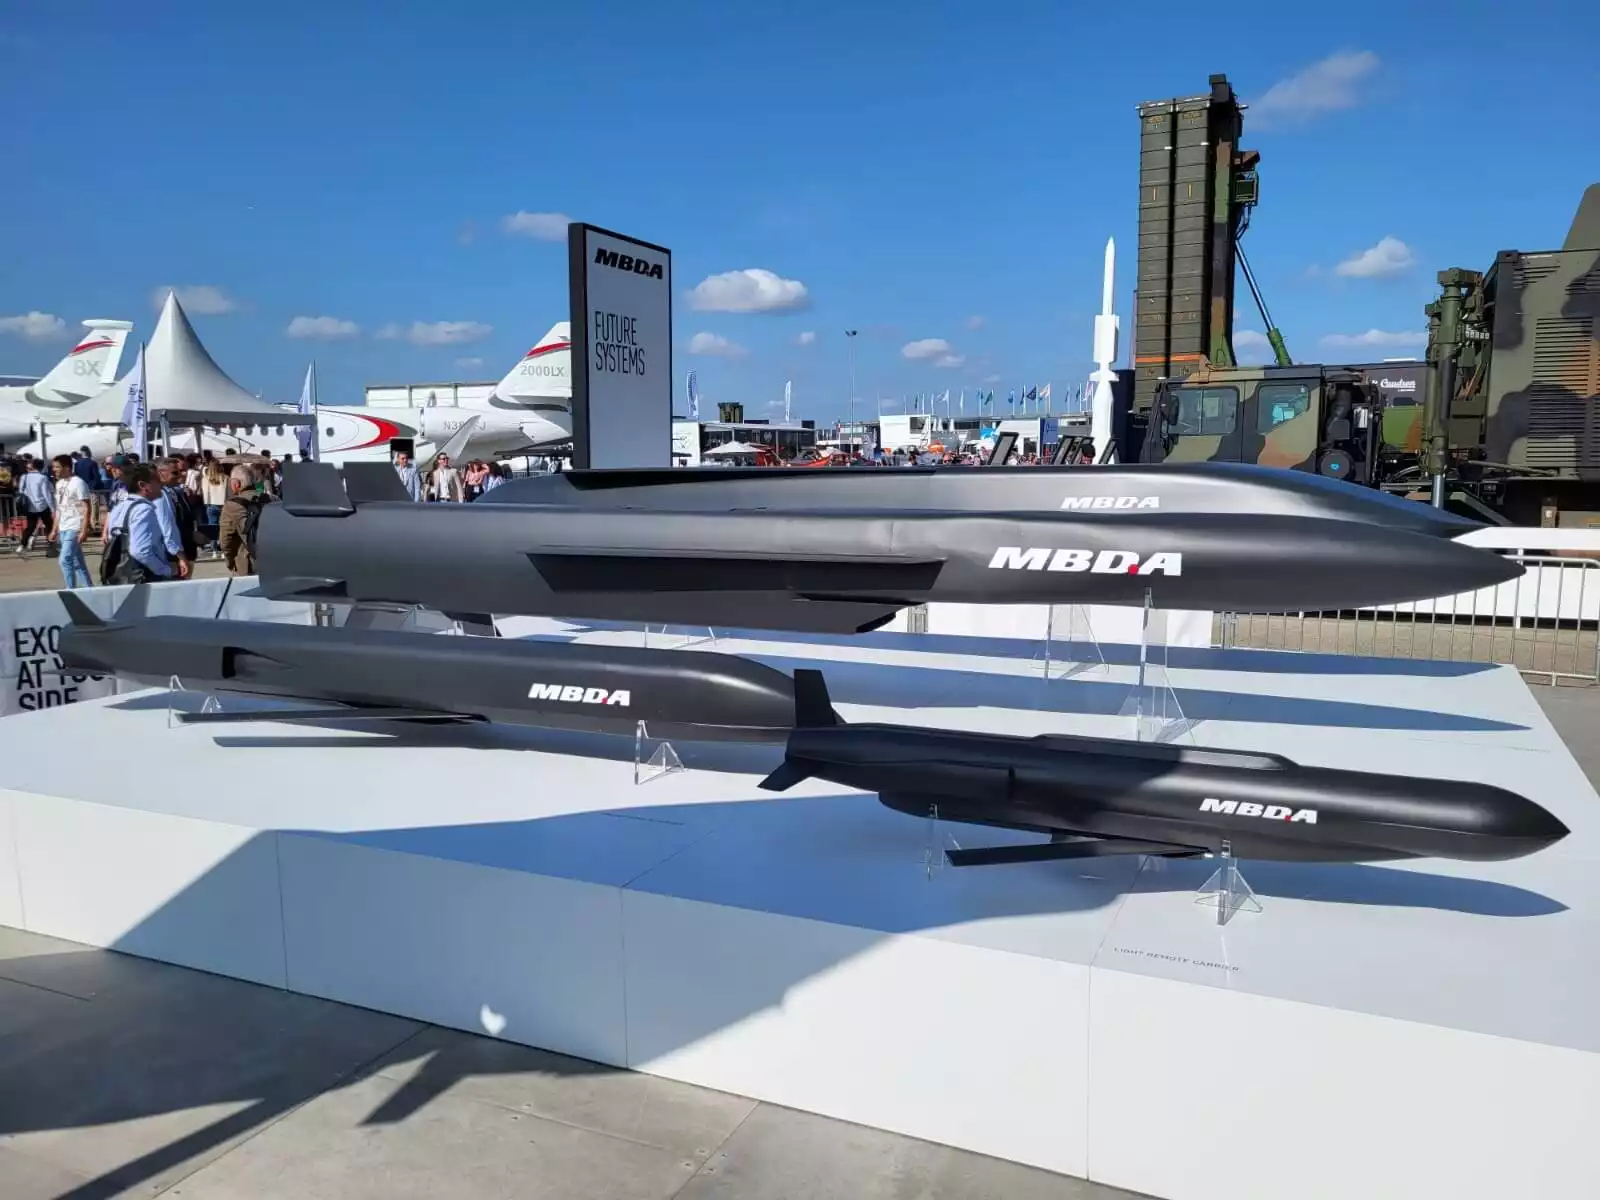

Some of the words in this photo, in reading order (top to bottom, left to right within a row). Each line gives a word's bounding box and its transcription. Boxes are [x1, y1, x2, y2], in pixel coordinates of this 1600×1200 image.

[594, 247, 663, 280] MBDA
[595, 310, 637, 346] FUTURE
[73, 359, 102, 377] 8X
[520, 364, 565, 377] 2000LX
[595, 341, 645, 376] SYSTEMS
[1060, 495, 1160, 509] MBDA
[988, 546, 1182, 576] MBDA
[17, 658, 46, 690] AT
[527, 682, 631, 707] MBDA
[1199, 797, 1318, 825] MBDA
